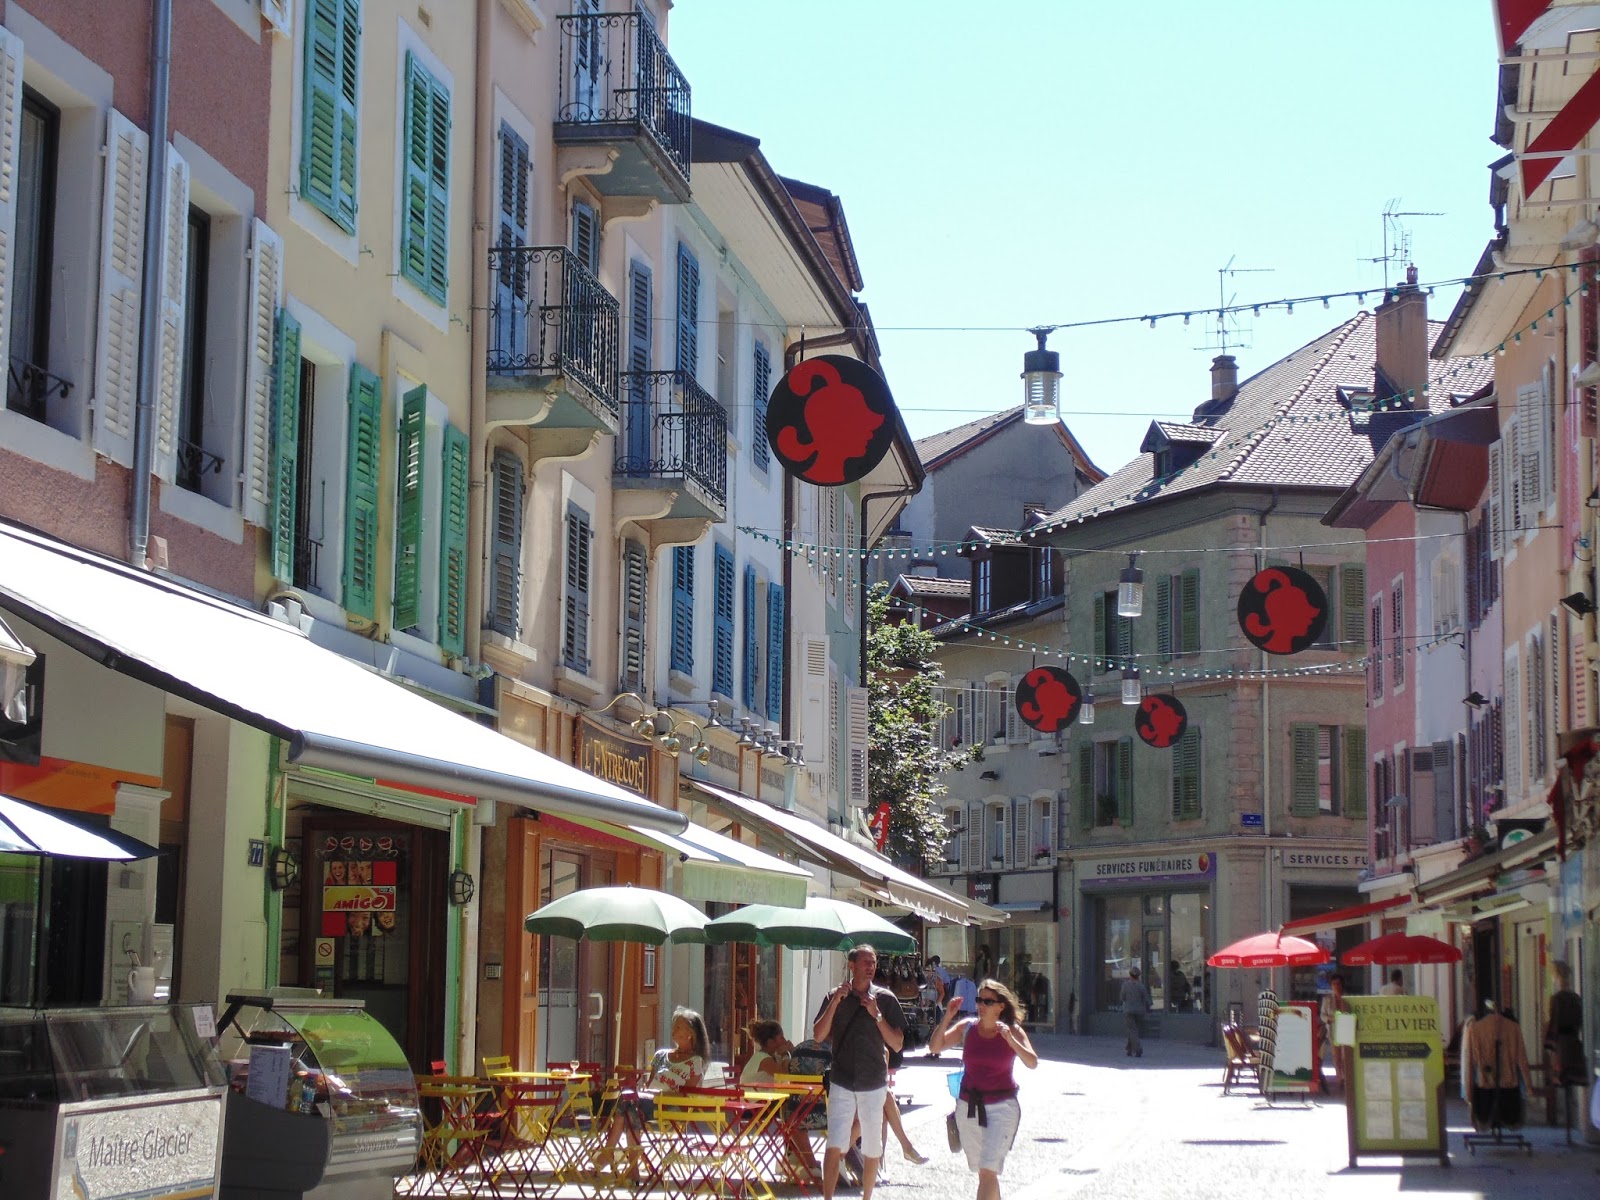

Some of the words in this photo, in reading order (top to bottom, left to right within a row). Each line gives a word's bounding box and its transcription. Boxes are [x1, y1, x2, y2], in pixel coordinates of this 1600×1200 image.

[252, 843, 262, 863] 77
[1290, 854, 1349, 865] SERVICES
[1097, 861, 1136, 875] SERVICES
[1139, 858, 1192, 872] FUNÉRAIRES
[1354, 1004, 1436, 1014] RESTAURANT
[142, 1125, 193, 1160] Glacier
